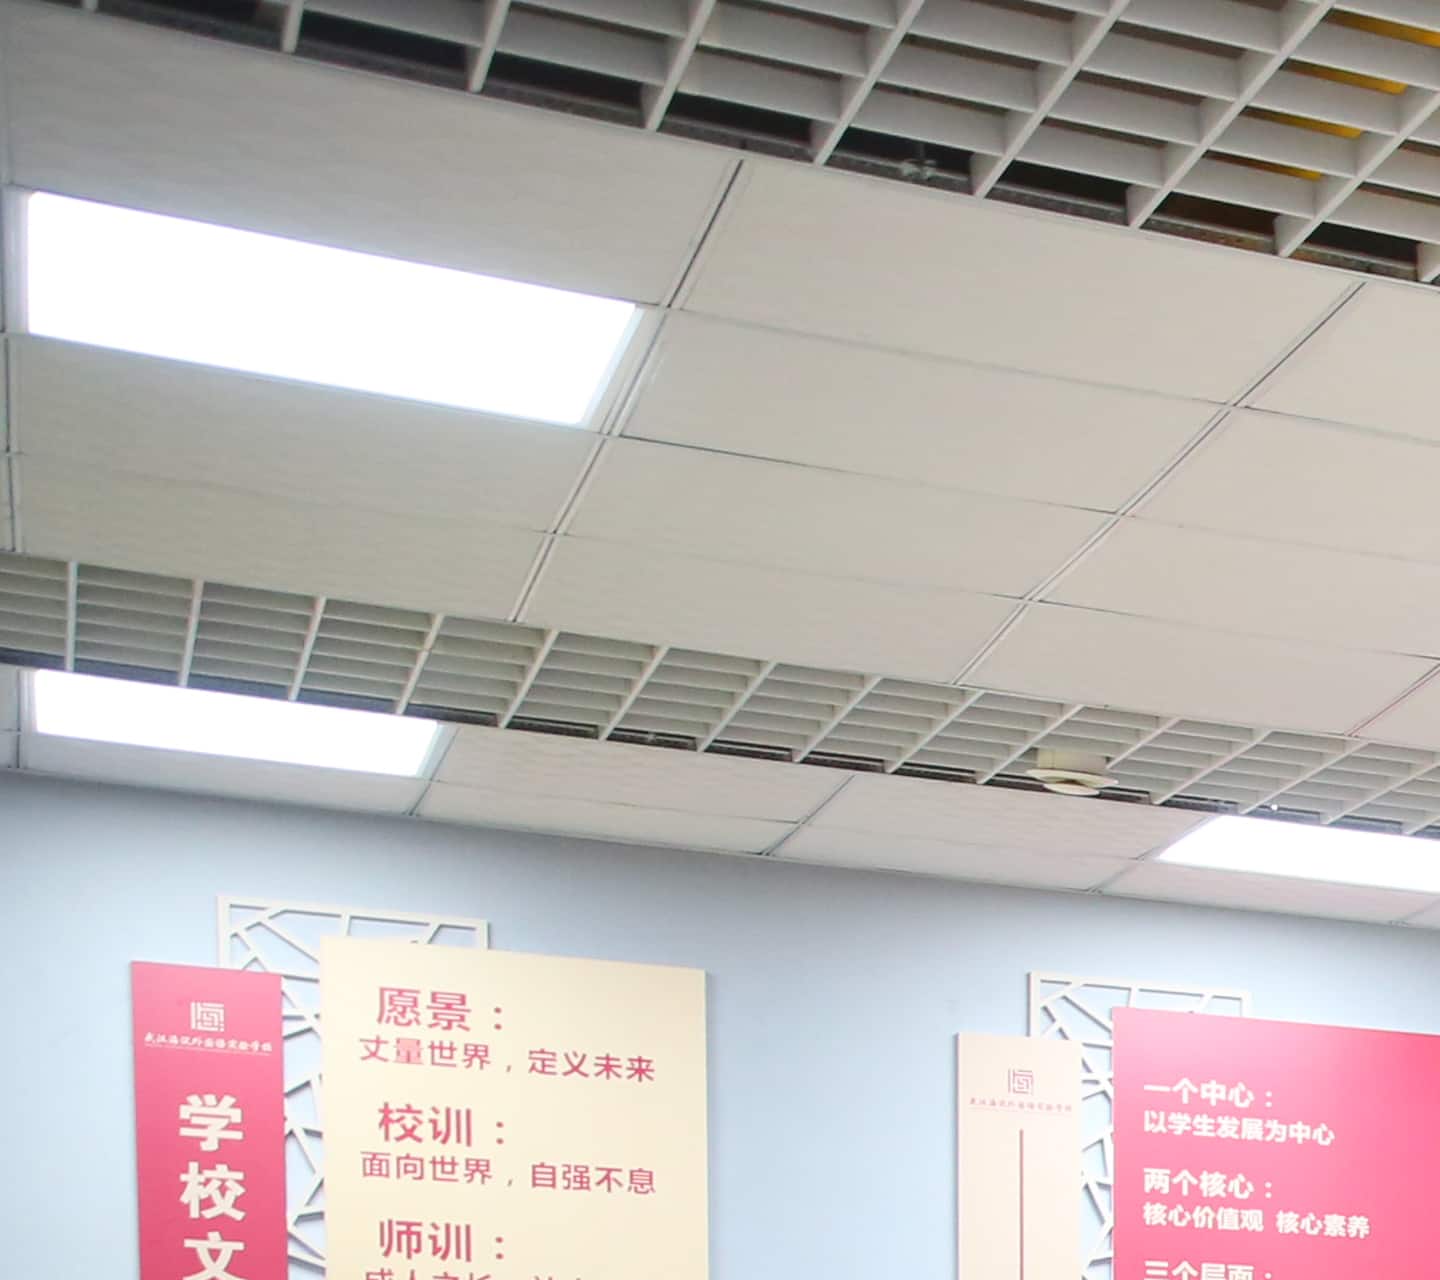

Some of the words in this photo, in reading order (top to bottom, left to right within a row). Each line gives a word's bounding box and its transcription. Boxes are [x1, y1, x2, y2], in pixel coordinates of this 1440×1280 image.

[376, 986, 505, 1034] 愿景：
[360, 1037, 656, 1085] 丈量世界，定义未来
[1143, 1078, 1274, 1109] 一个中心：
[377, 1104, 505, 1149] 校训：
[1143, 1111, 1335, 1146] 以学生发展为中心
[360, 1150, 657, 1196] 面向世界，自强不息
[1143, 1168, 1274, 1200] 两个核心：
[377, 1221, 506, 1264] 师训：
[1143, 1204, 1264, 1233] 核心价值观
[1276, 1211, 1370, 1239] 核心素养
